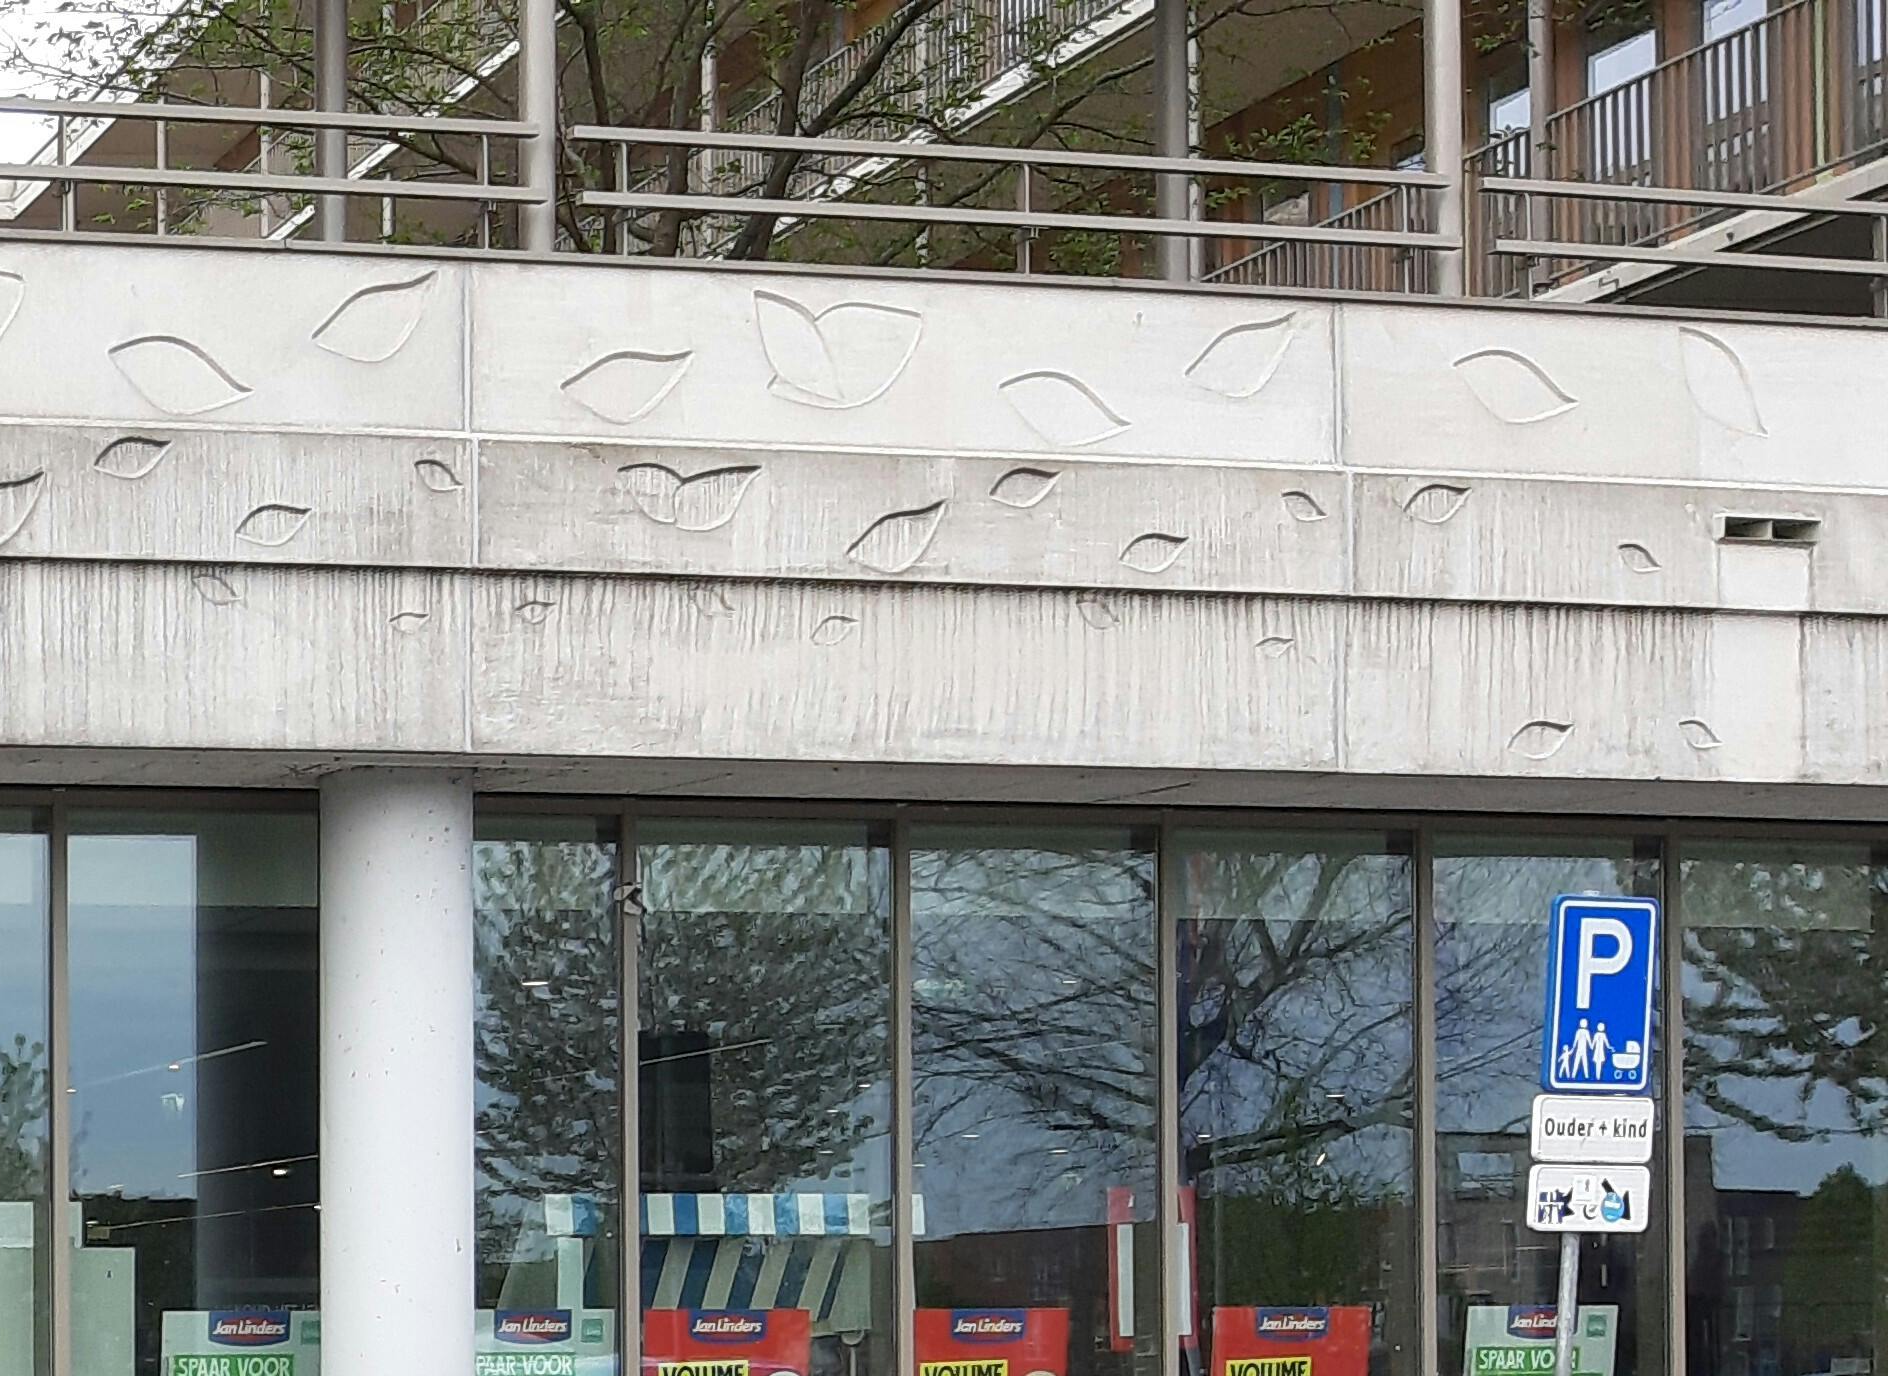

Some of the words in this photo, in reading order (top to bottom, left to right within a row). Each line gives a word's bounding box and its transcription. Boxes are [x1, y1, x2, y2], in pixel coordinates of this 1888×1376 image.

[1576, 917, 1633, 1009] P
[1544, 1117, 1594, 1139] Ouder
[1612, 1118, 1647, 1139] kind
[213, 1320, 236, 1335] Jan
[238, 1319, 286, 1336] Linders
[498, 1319, 521, 1333] Jan
[523, 1317, 567, 1333] Linders
[692, 1319, 716, 1333] Jan
[717, 1318, 762, 1333] Linders
[954, 1319, 976, 1333] Jan
[977, 1318, 1024, 1333] Linders
[1259, 1317, 1280, 1330] Jan
[1281, 1316, 1325, 1330] Linders
[1510, 1315, 1532, 1328] Jan
[1533, 1314, 1558, 1328] Lind
[476, 1355, 516, 1376] PAAR
[524, 1355, 572, 1376] VOOR
[1479, 1350, 1525, 1370] SPAAR
